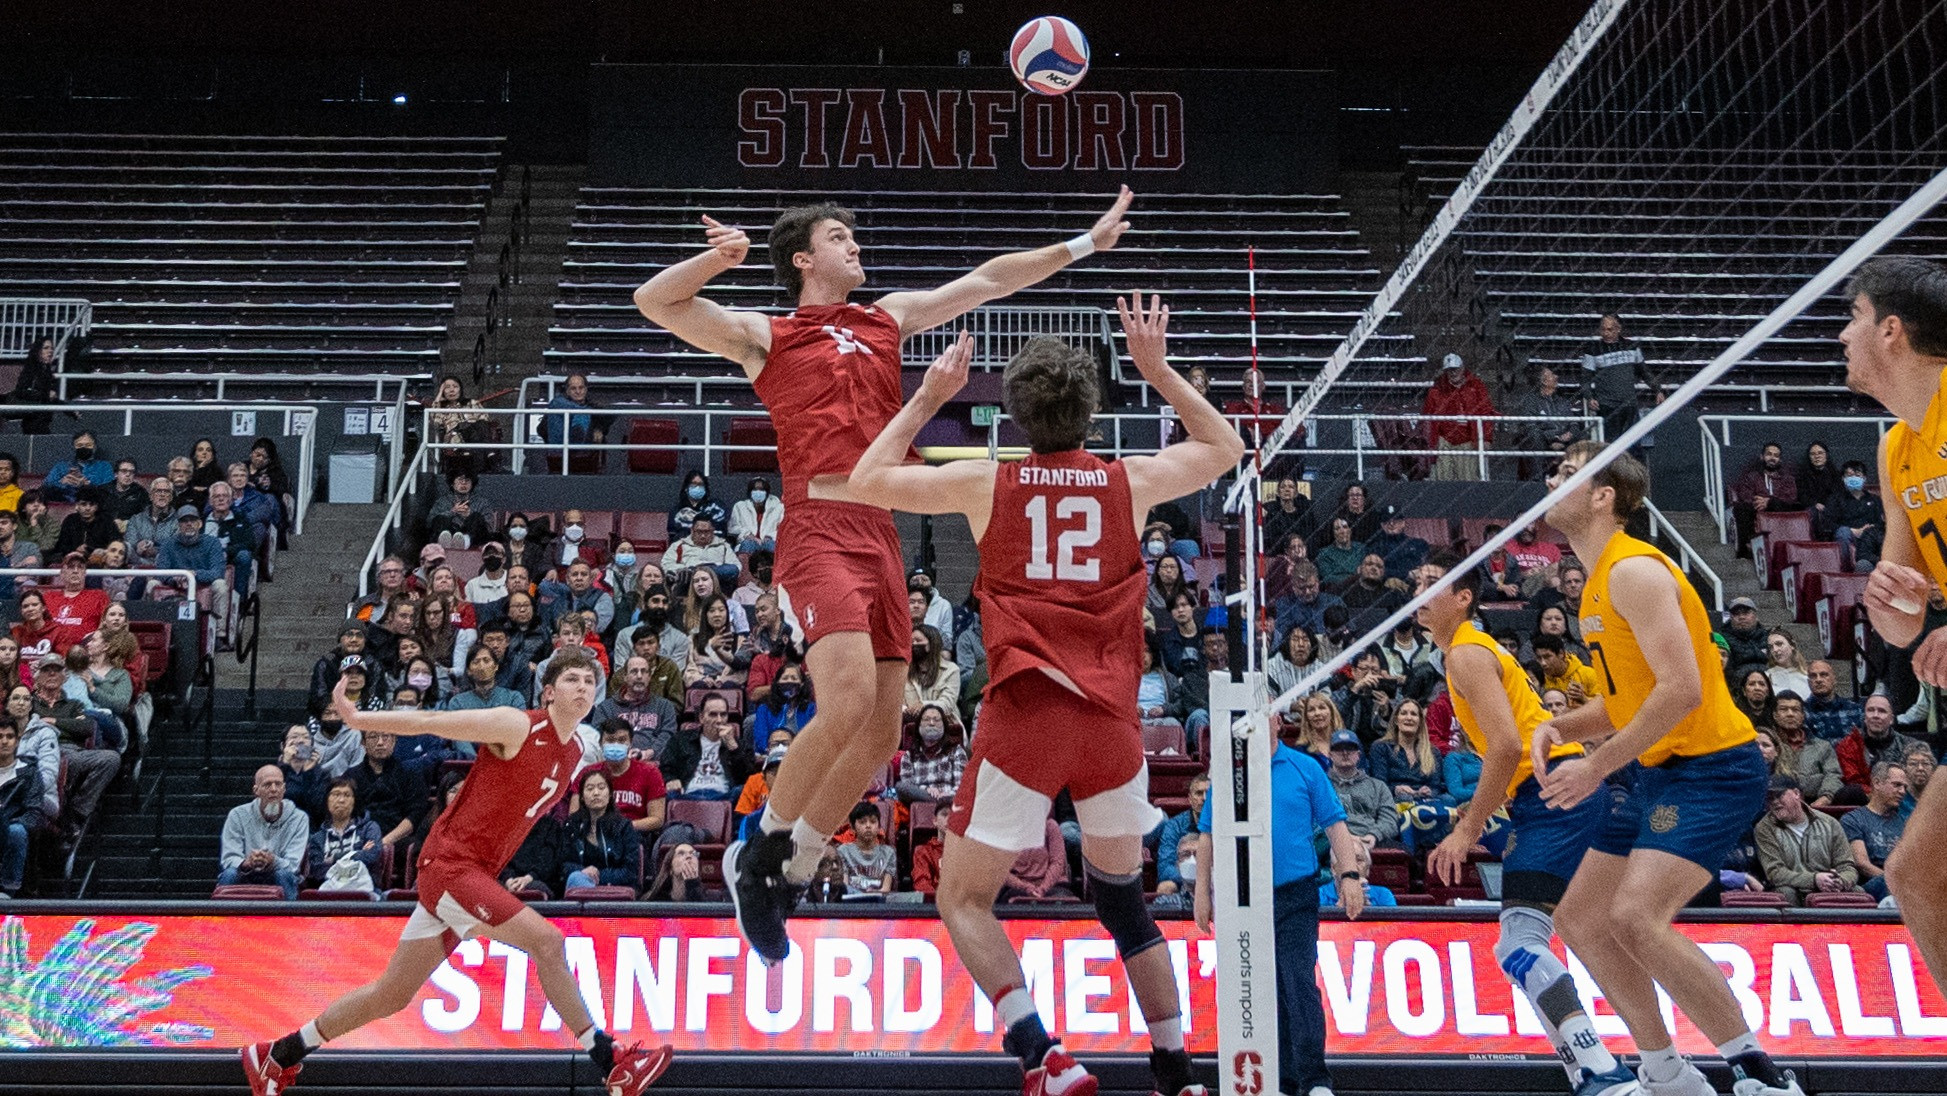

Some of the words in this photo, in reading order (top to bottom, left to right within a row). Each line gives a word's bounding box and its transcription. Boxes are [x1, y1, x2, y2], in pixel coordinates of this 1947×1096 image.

[738, 88, 1186, 170] STANFORD
[377, 414, 389, 431] 4
[1020, 466, 1108, 486] STANFORD
[1025, 495, 1102, 581] 12
[182, 607, 191, 619] 4
[525, 777, 559, 818] 7
[1237, 930, 1251, 978] sports
[422, 936, 942, 1034] STANFORD
[1238, 980, 1254, 1039] imports
[853, 1050, 911, 1058] DAKTRONICS
[1468, 1053, 1527, 1061] DAKTRONICS
